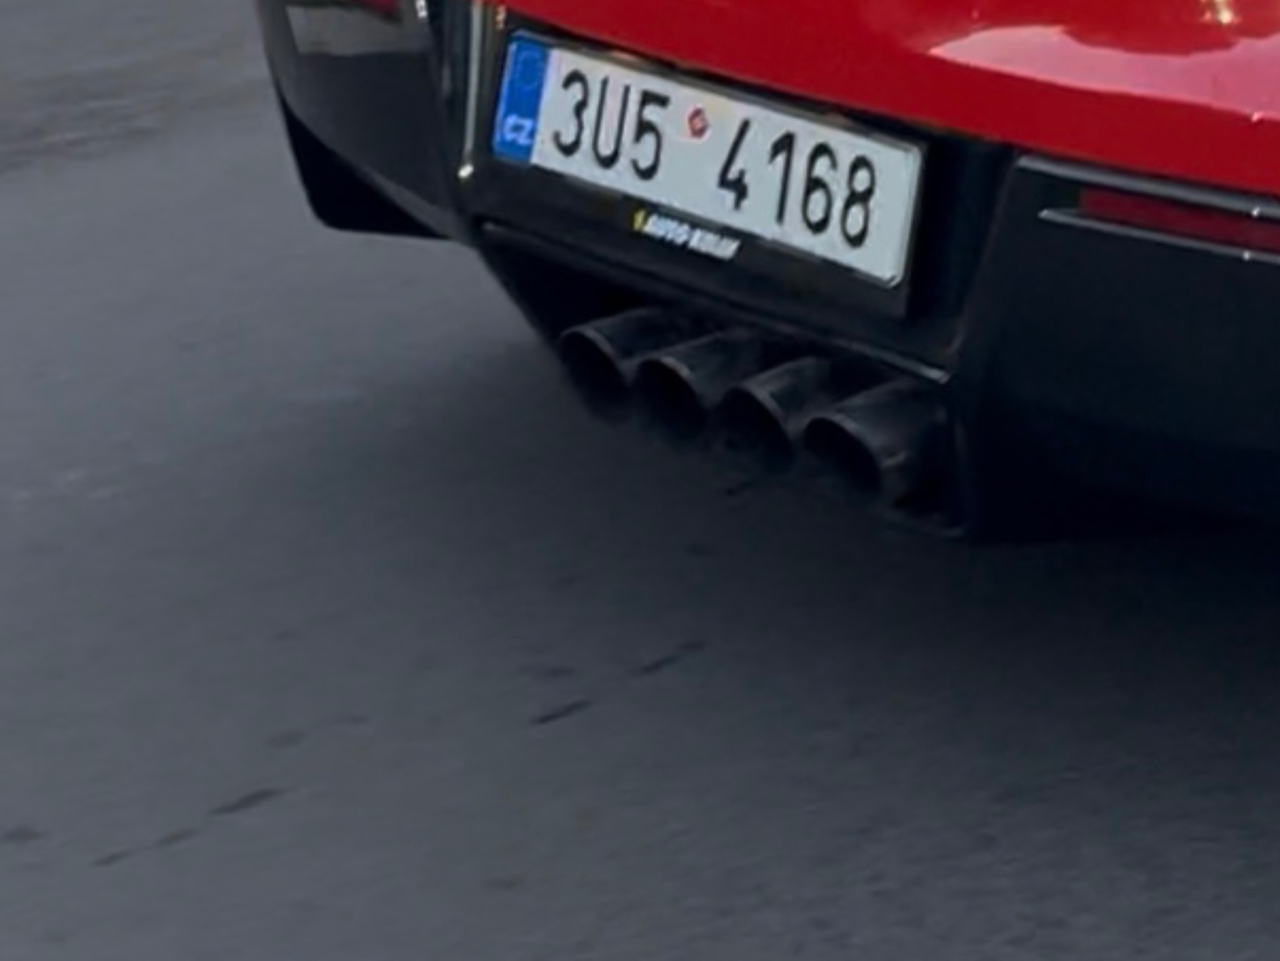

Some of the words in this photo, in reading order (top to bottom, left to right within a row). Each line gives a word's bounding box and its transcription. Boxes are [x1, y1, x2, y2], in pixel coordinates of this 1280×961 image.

[503, 114, 535, 146] CZ
[553, 69, 671, 181] 3U5
[717, 118, 876, 249] 4168
